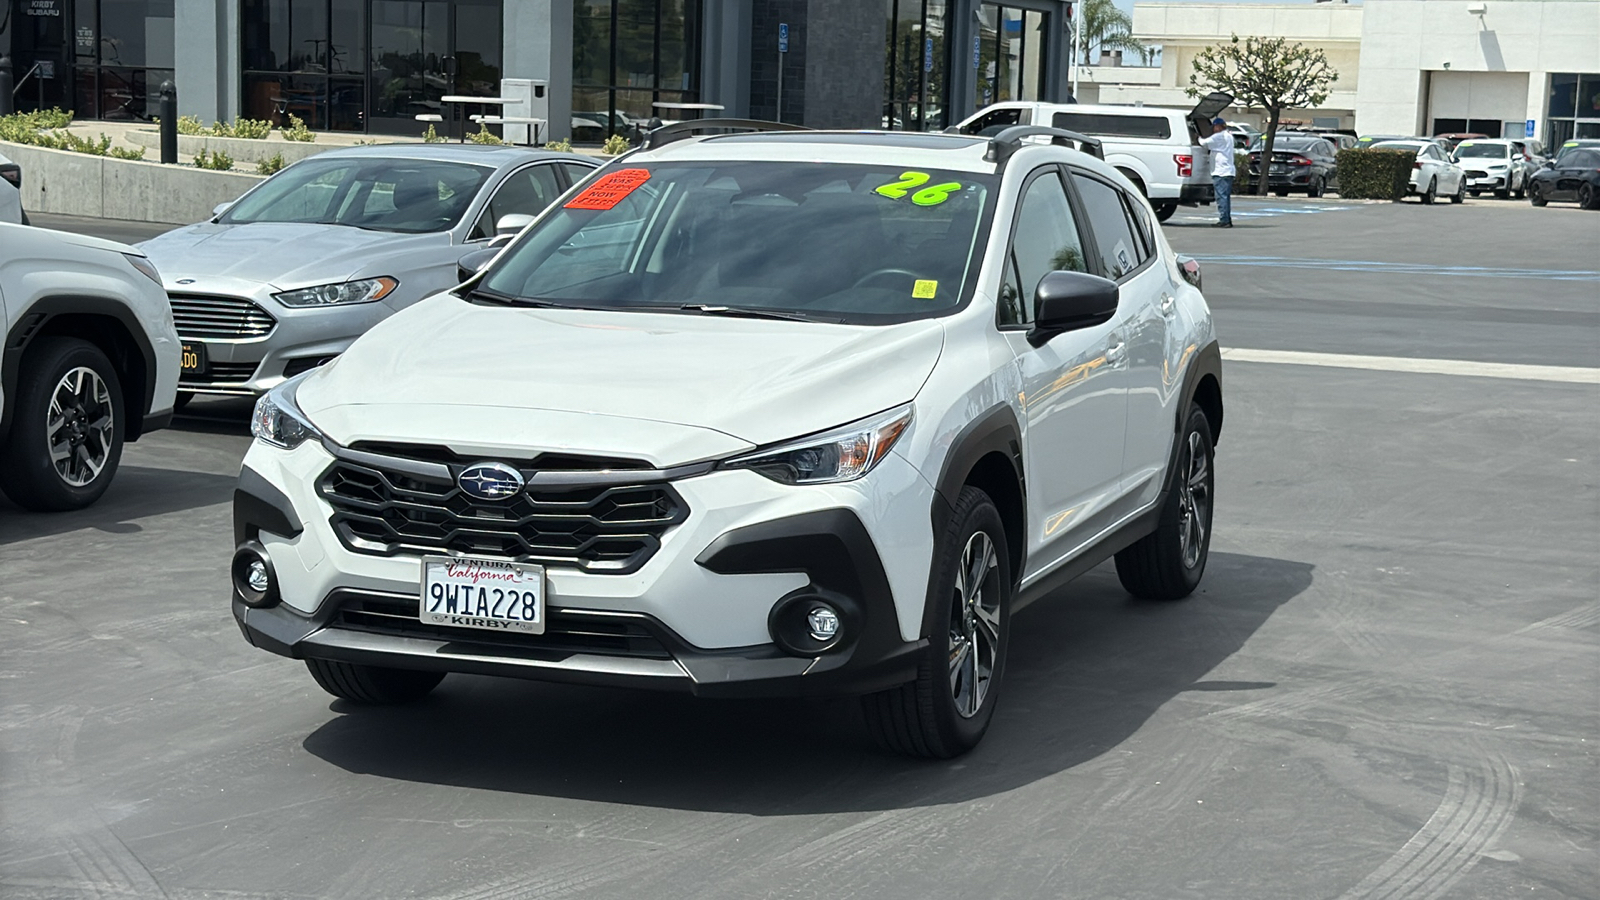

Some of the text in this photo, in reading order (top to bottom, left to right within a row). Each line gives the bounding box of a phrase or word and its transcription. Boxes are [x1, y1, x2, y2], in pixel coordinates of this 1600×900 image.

[875, 171, 962, 206] 26
[448, 563, 522, 584] California
[453, 558, 513, 569] VENTURA
[430, 582, 536, 621] 9WIA228
[452, 616, 511, 629] KIRBY
